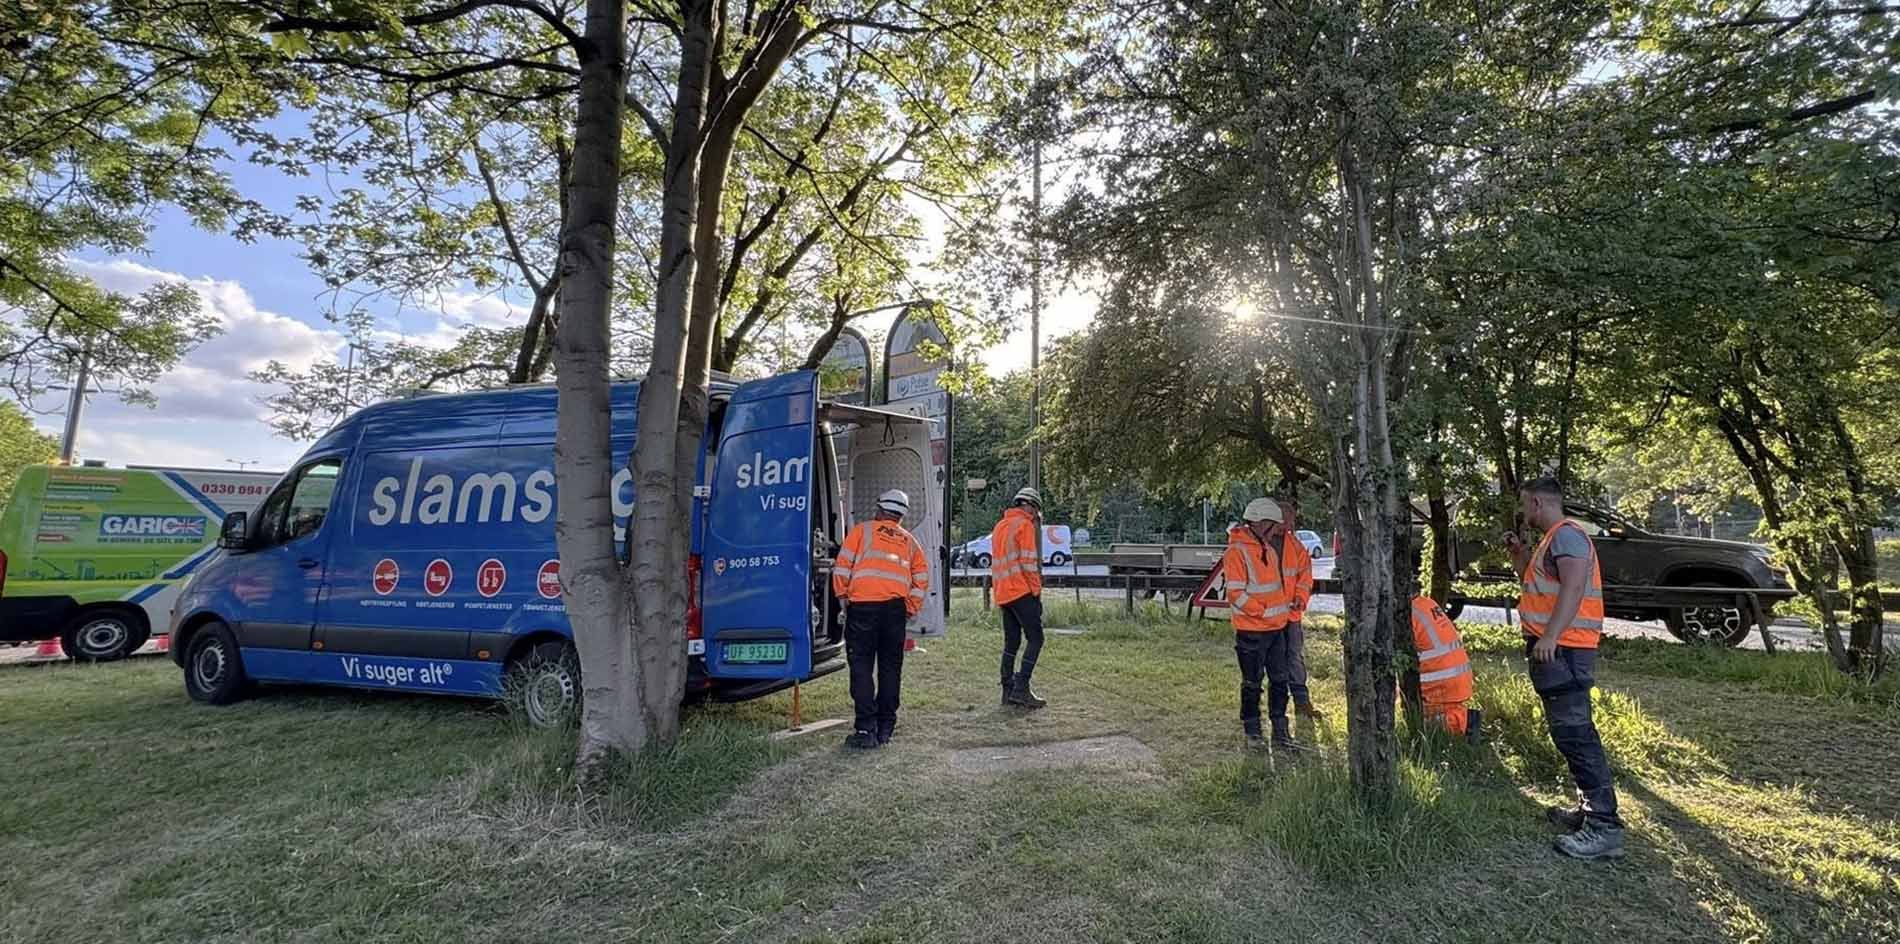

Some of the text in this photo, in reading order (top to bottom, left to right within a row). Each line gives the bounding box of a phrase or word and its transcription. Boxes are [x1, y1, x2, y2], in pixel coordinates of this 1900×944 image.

[201, 483, 235, 495] 0330
[760, 494, 806, 511] Vi sug
[103, 516, 178, 535] GARIC
[729, 558, 747, 568] 900
[748, 645, 784, 659] 95230
[341, 656, 361, 678] Vi
[364, 664, 415, 686] suger
